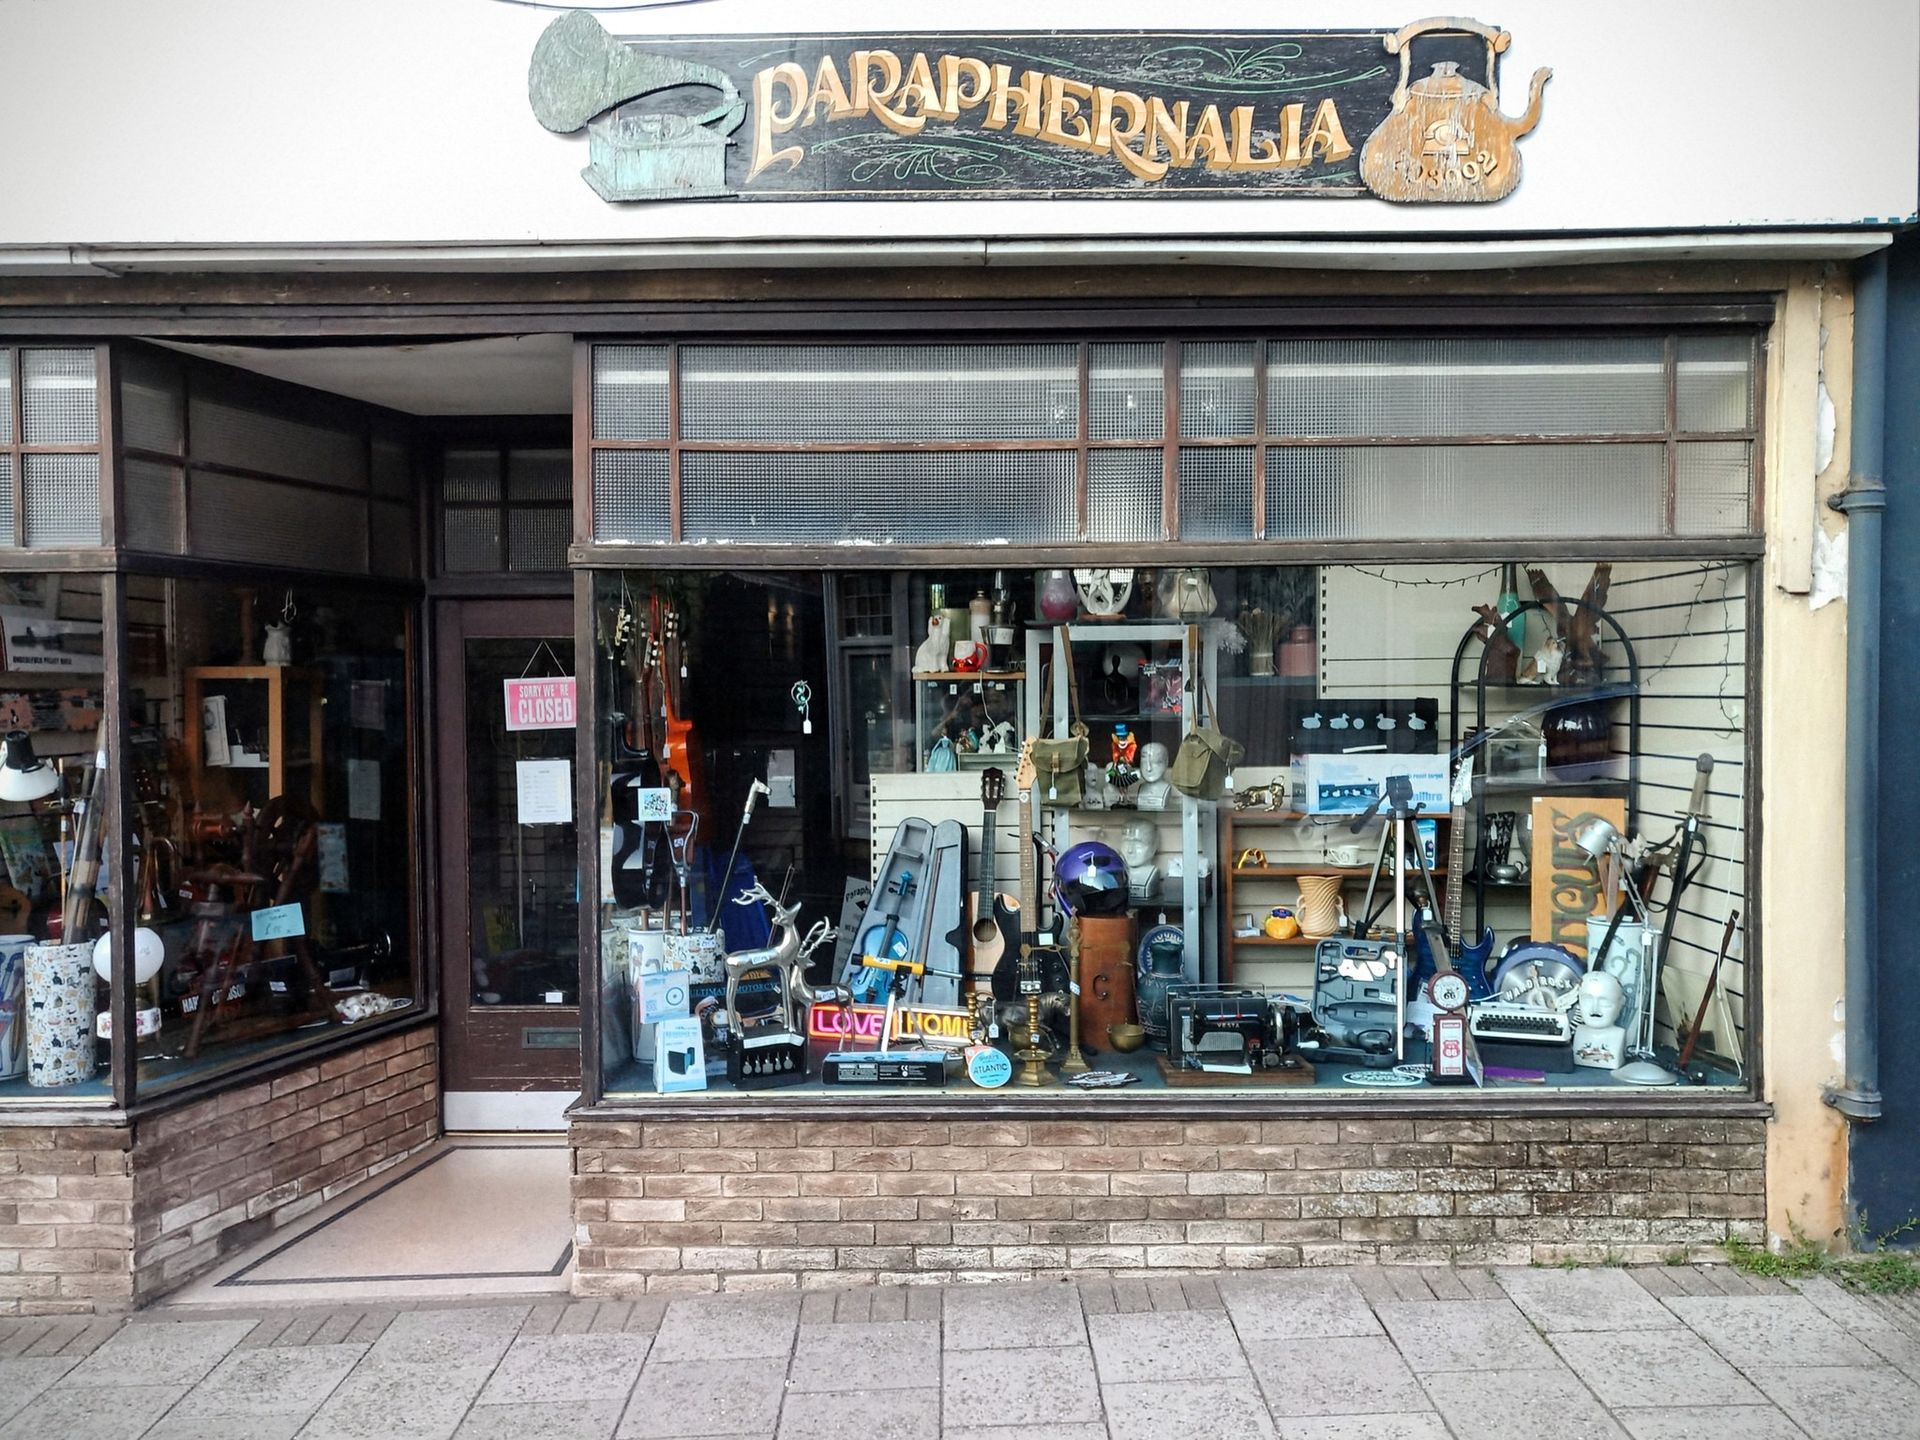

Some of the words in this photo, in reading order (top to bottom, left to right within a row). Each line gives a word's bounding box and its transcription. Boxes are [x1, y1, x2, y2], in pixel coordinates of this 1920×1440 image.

[748, 48, 1353, 183] PARAPHERNALIA
[519, 685, 541, 698] SORRY
[519, 698, 572, 724] CLOSED
[690, 985, 728, 998] ULTIMAT
[1443, 990, 1456, 1000] 66
[1505, 978, 1534, 1001] HARD
[1538, 976, 1574, 989] ROCK
[817, 1010, 884, 1037] LOVE
[973, 1063, 1008, 1075] ATLANTIC
